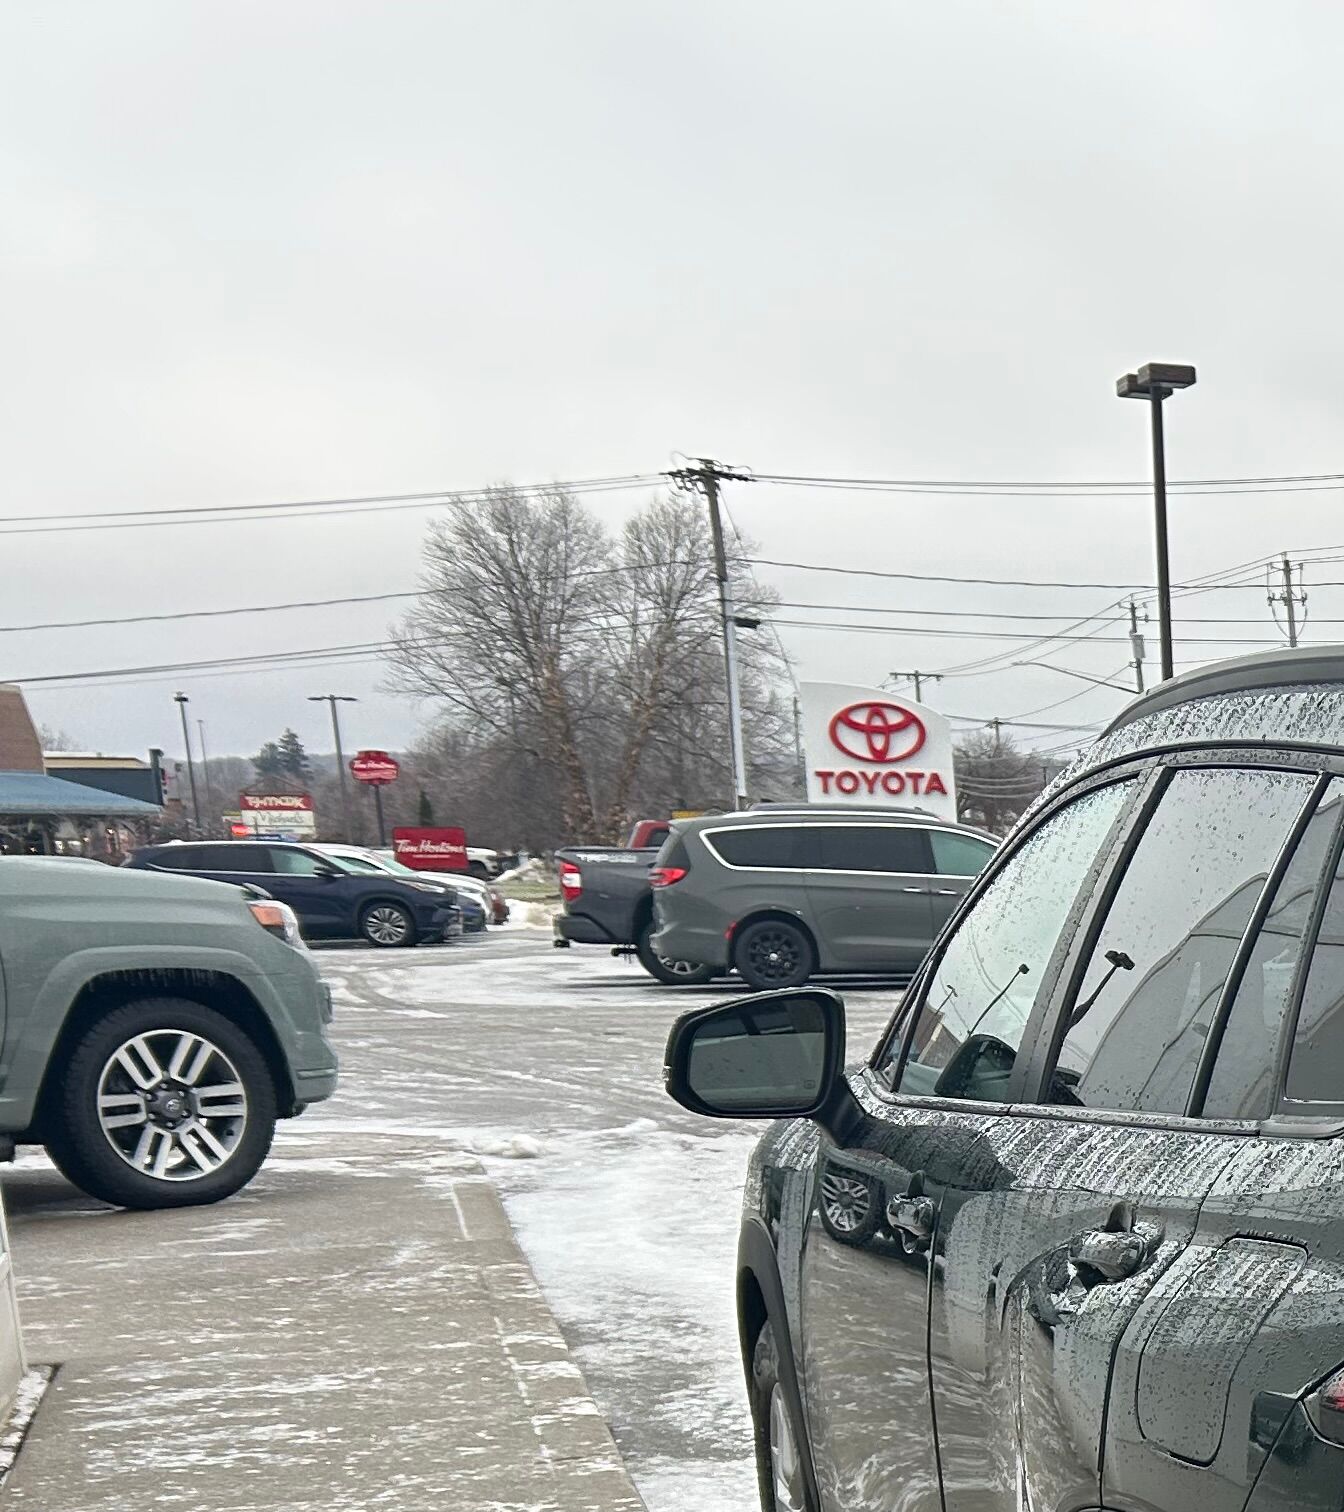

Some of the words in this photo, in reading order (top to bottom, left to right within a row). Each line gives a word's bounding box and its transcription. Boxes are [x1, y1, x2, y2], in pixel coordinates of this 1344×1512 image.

[815, 770, 947, 796] TOYOTA
[395, 839, 417, 853] Tim
[419, 839, 465, 853] Hortons
